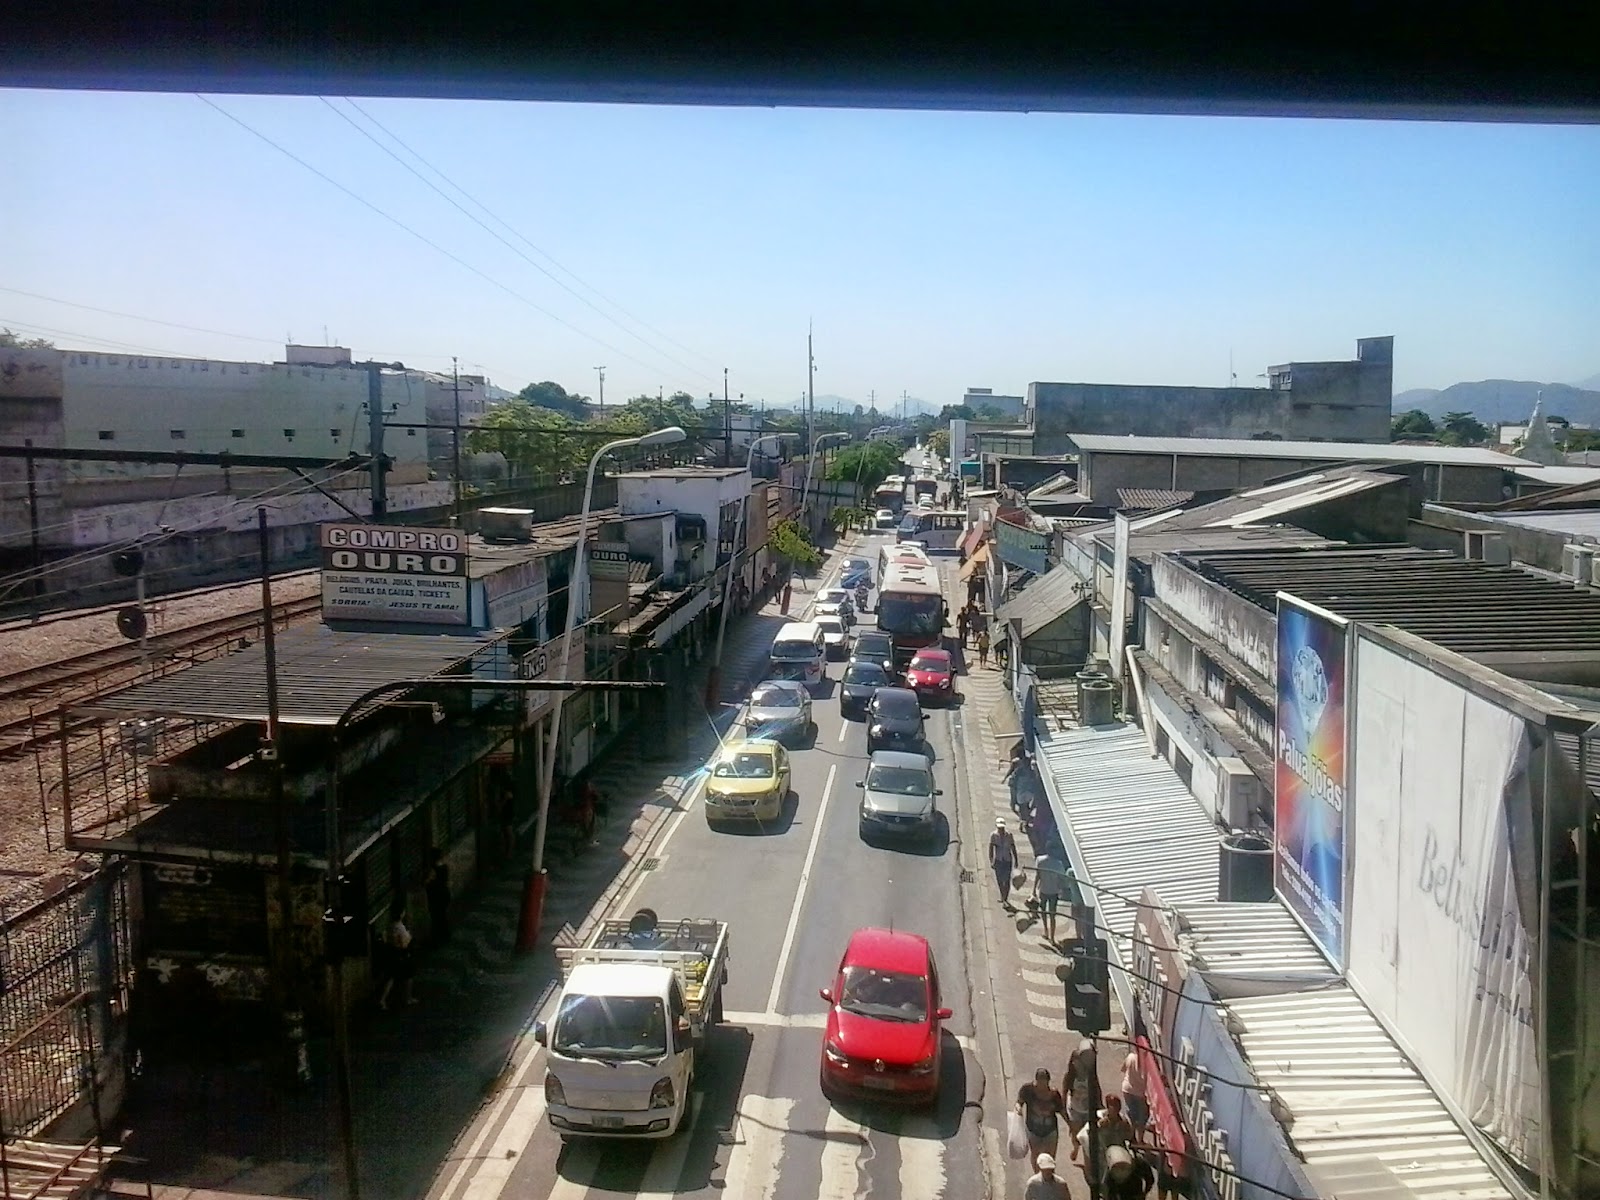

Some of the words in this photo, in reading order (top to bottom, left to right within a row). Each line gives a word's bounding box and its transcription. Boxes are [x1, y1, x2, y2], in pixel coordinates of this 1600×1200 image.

[329, 528, 459, 551] COMPRO
[331, 550, 457, 574] OURO
[592, 551, 627, 560] OURO
[389, 601, 418, 609] JESUS
[1279, 728, 1309, 785] Palua
